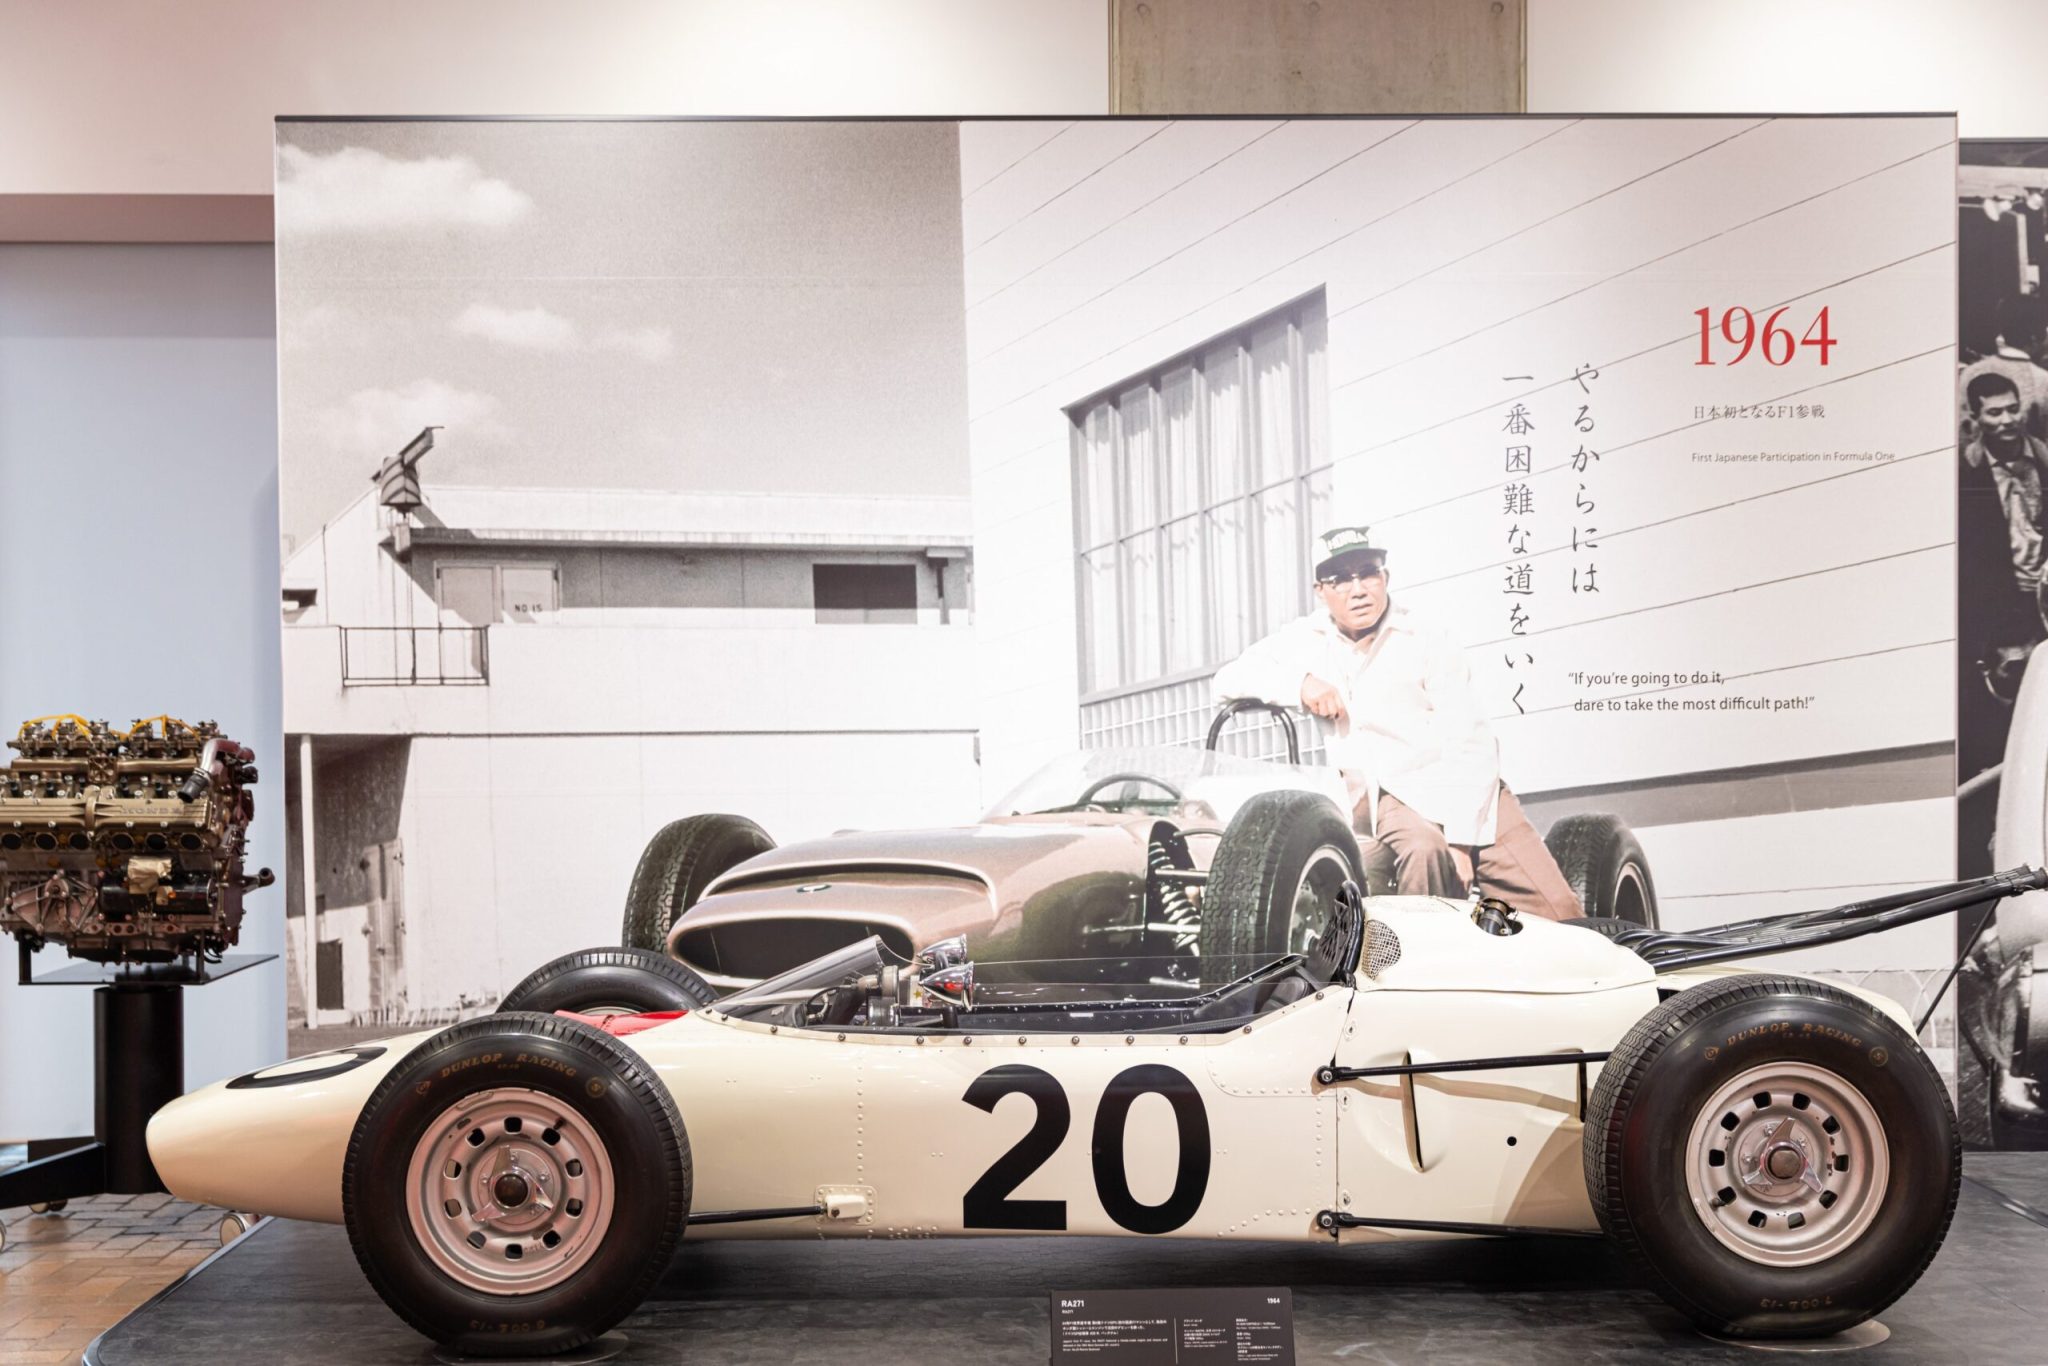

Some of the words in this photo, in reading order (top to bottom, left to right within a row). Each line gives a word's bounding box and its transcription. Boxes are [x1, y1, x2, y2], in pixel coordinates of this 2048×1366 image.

[1693, 305, 1838, 366] 1964
[1693, 404, 1826, 419] 日本初となるF1参戦
[1692, 452, 1713, 462] First
[1714, 452, 1759, 464] Japanese
[1760, 452, 1821, 464] Participation
[1822, 452, 1832, 461] in
[1833, 451, 1873, 461] Formula
[1874, 451, 1895, 461] One
[1570, 362, 1600, 594] やるからには
[1502, 375, 1536, 715] 一番困難な道をいく
[1631, 672, 1670, 687] going
[1674, 672, 1687, 684] to
[1691, 671, 1709, 684] do
[1711, 671, 1725, 685] it,
[1574, 698, 1604, 712] dare
[1607, 699, 1621, 711] to
[1625, 698, 1654, 711] take
[1657, 697, 1679, 711] the
[1683, 698, 1716, 710] most
[1719, 696, 1770, 710] difficult
[1727, 1022, 1790, 1047] DUNLOP
[1802, 1022, 1863, 1048] RACING
[441, 1053, 504, 1078] DUNLOP
[516, 1053, 577, 1078] RACING
[961, 1063, 1212, 1235] 20
[1061, 1299, 1085, 1308] RA271
